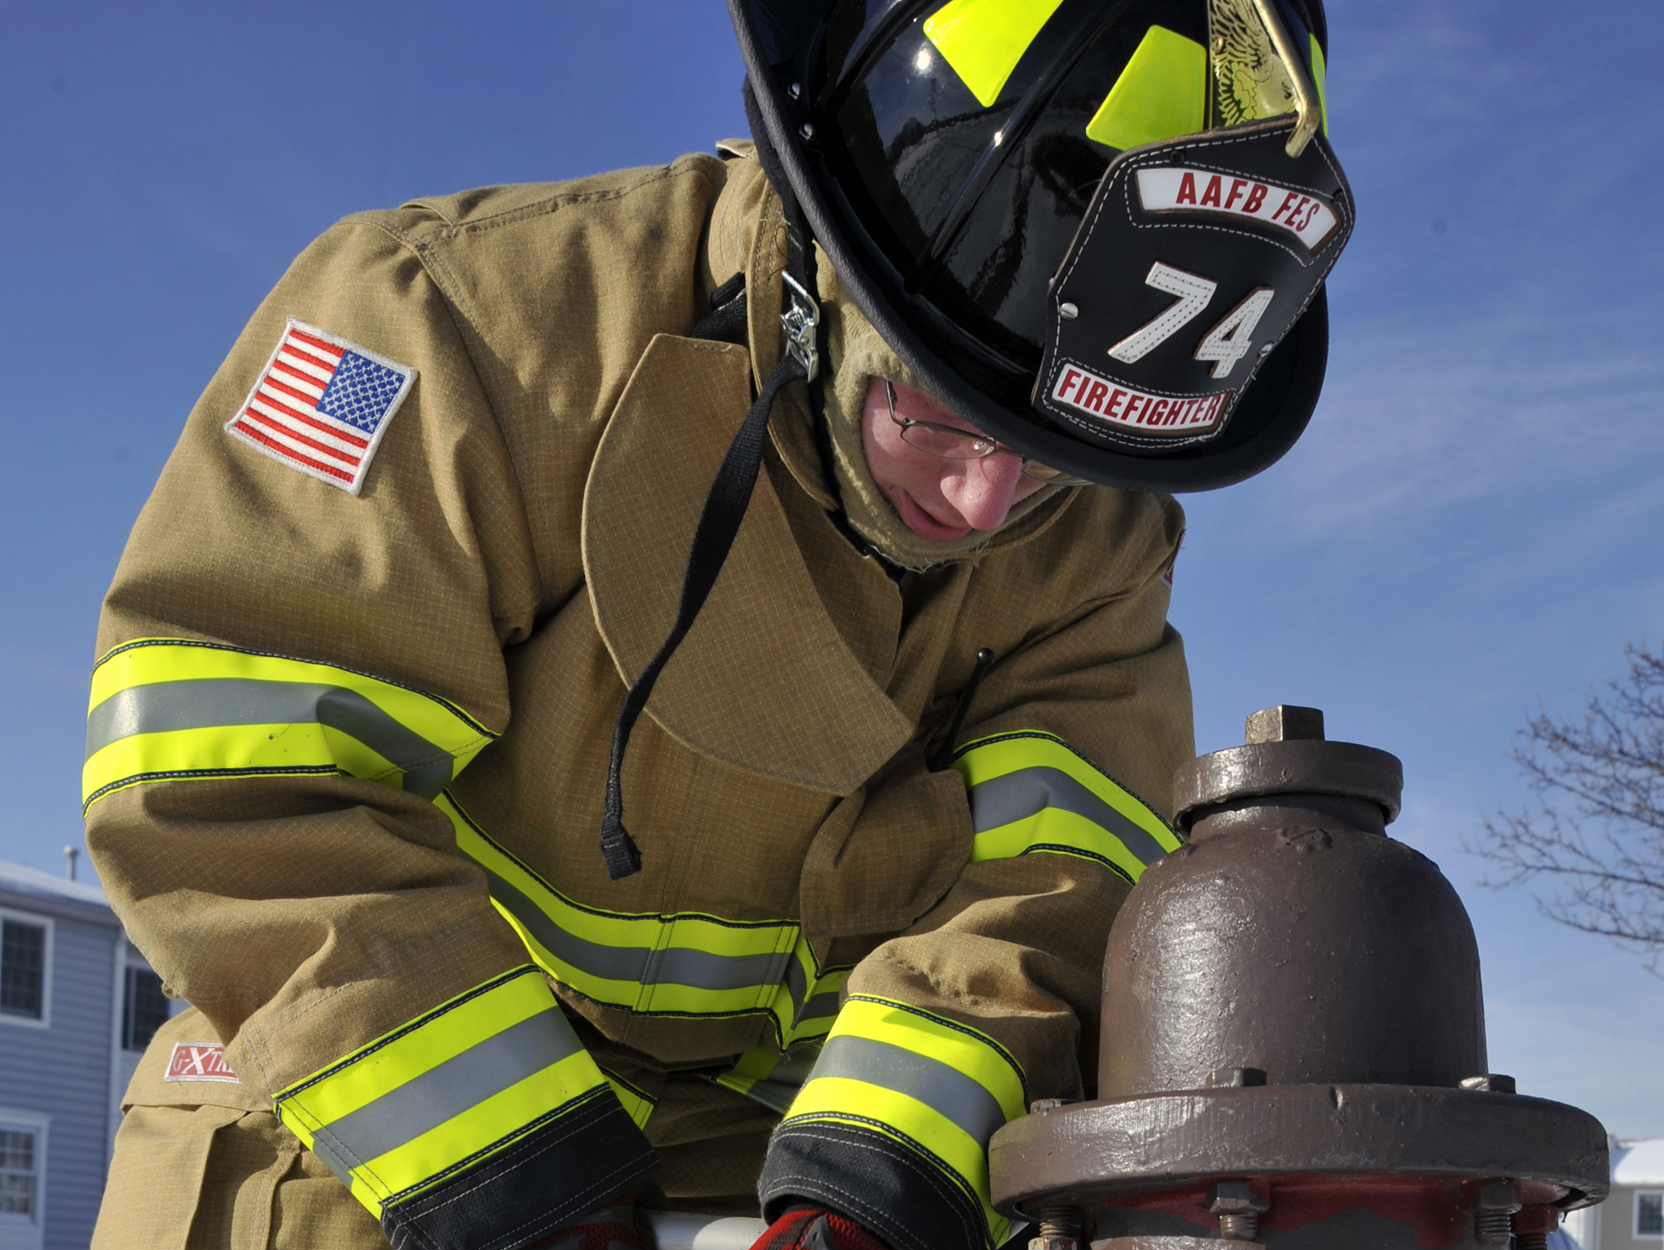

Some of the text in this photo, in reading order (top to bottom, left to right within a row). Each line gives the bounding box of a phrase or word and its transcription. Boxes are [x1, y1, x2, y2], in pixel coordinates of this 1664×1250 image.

[1175, 172, 1319, 232] AAFB FES
[1107, 261, 1275, 379] 74
[1057, 370, 1224, 426] FIREFIGHTER
